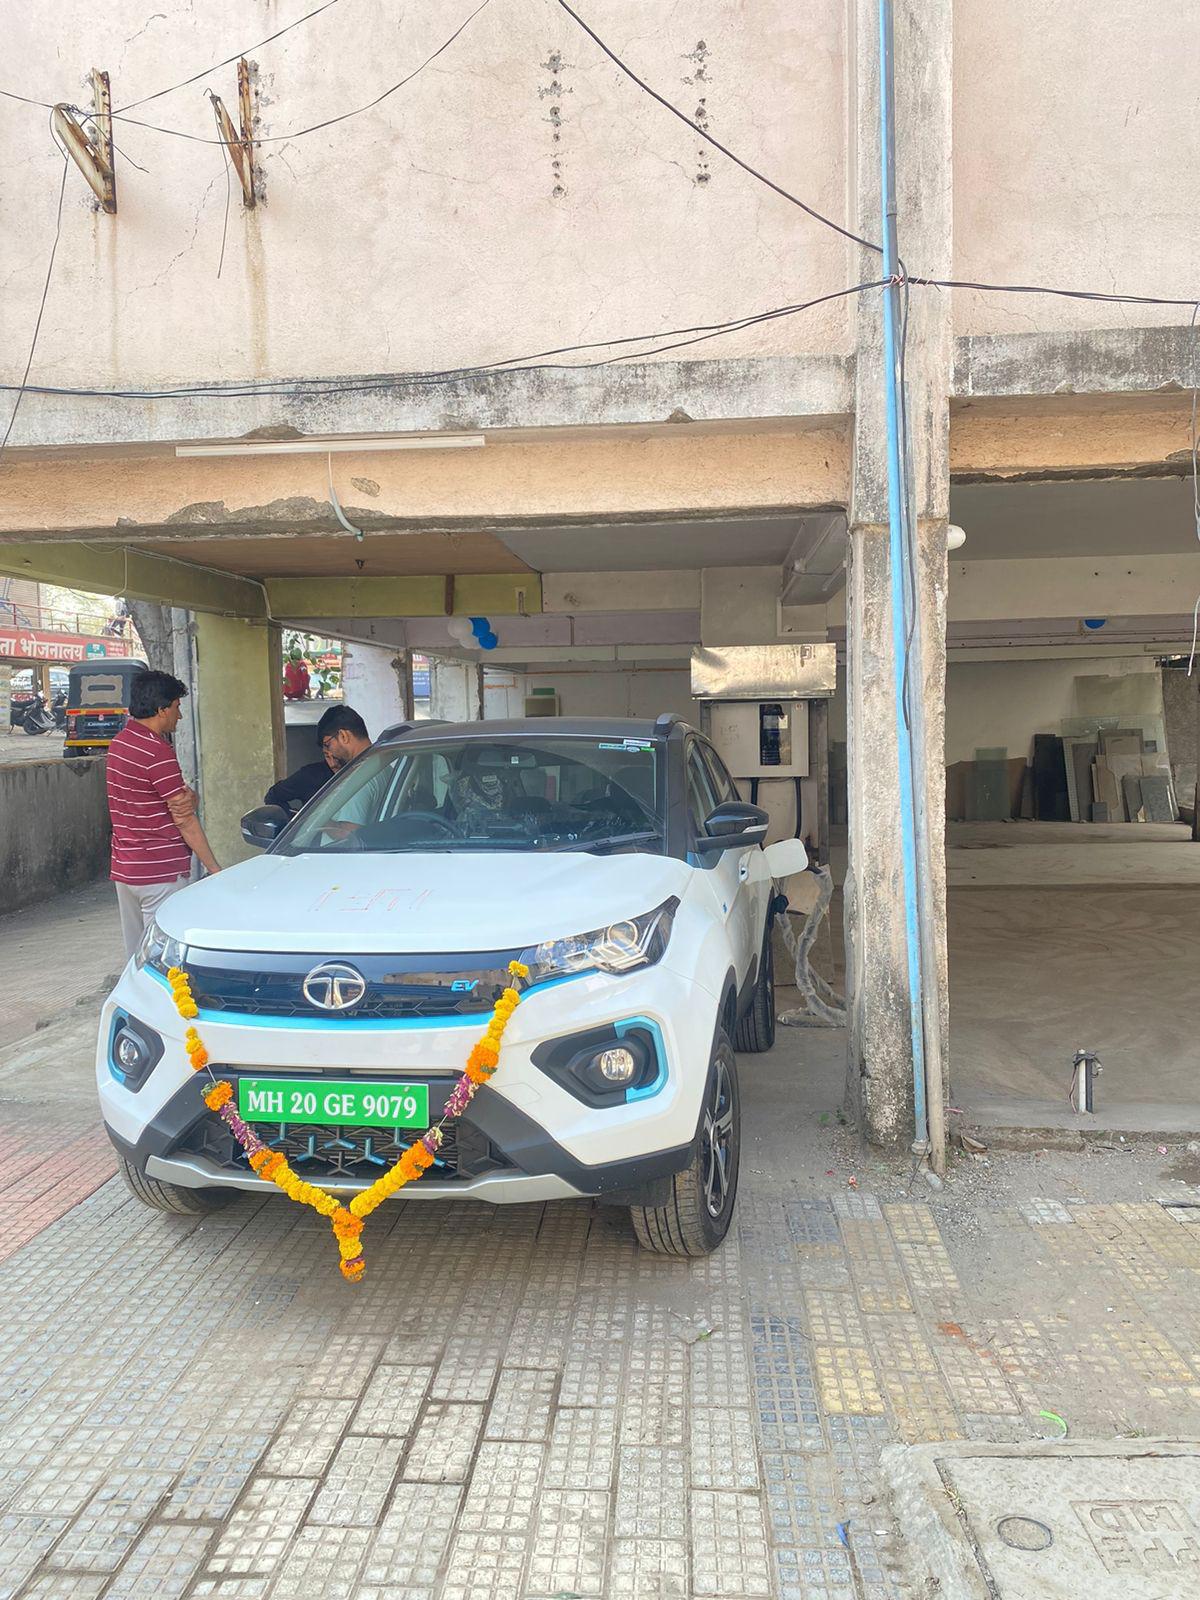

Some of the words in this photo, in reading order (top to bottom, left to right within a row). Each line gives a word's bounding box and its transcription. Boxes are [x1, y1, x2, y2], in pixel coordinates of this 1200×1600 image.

[20, 633, 84, 660] भोजनालय
[451, 979, 479, 992] EV
[247, 1090, 284, 1113] MH
[290, 1092, 317, 1115] 20
[323, 1093, 356, 1117] GE
[362, 1095, 417, 1119] 9079
